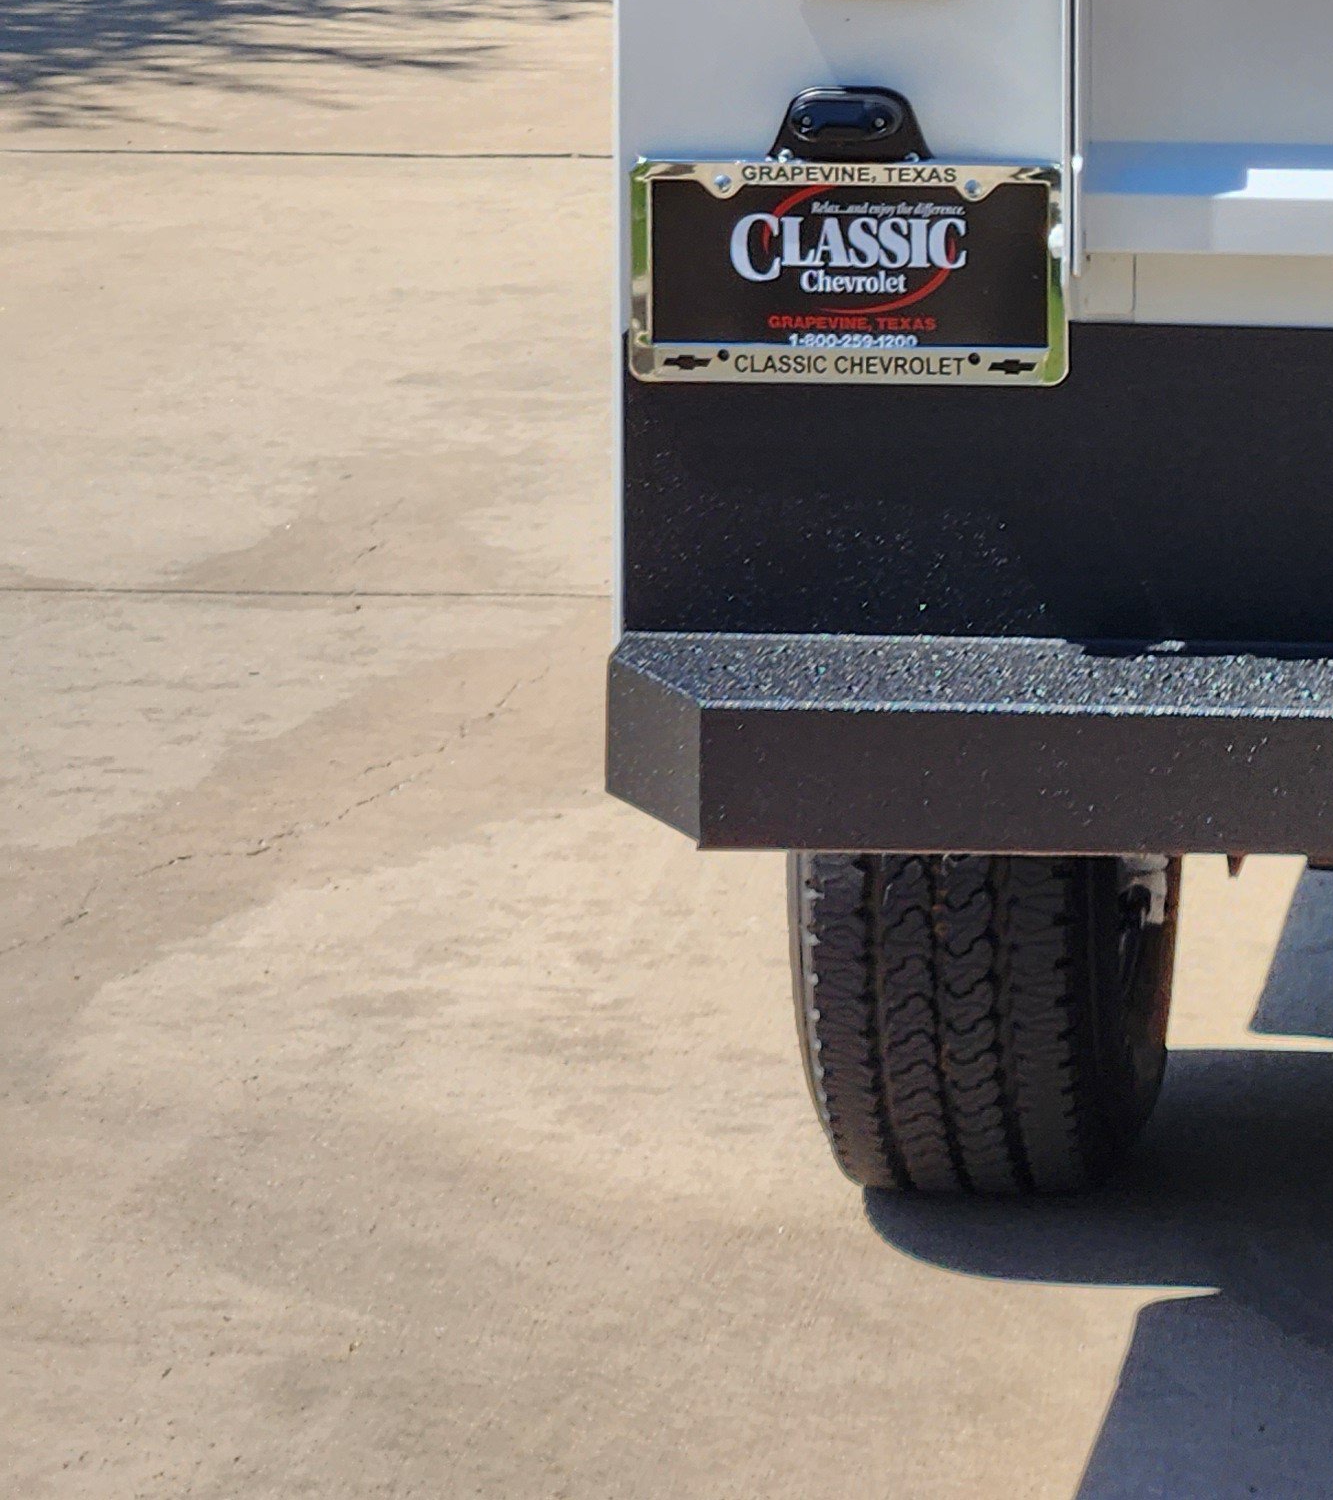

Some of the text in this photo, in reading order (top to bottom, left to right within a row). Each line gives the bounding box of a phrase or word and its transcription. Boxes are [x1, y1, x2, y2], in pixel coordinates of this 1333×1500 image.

[741, 165, 957, 184] GRAPEVINE, TEXAS
[869, 203, 896, 218] enjoy
[896, 201, 913, 215] the
[730, 212, 967, 282] CLASSIC
[800, 269, 907, 294] Chevrolet
[768, 315, 937, 331] GRAPEVINE, TEXAS
[734, 354, 965, 377] CLASSIC CHEVROLET
